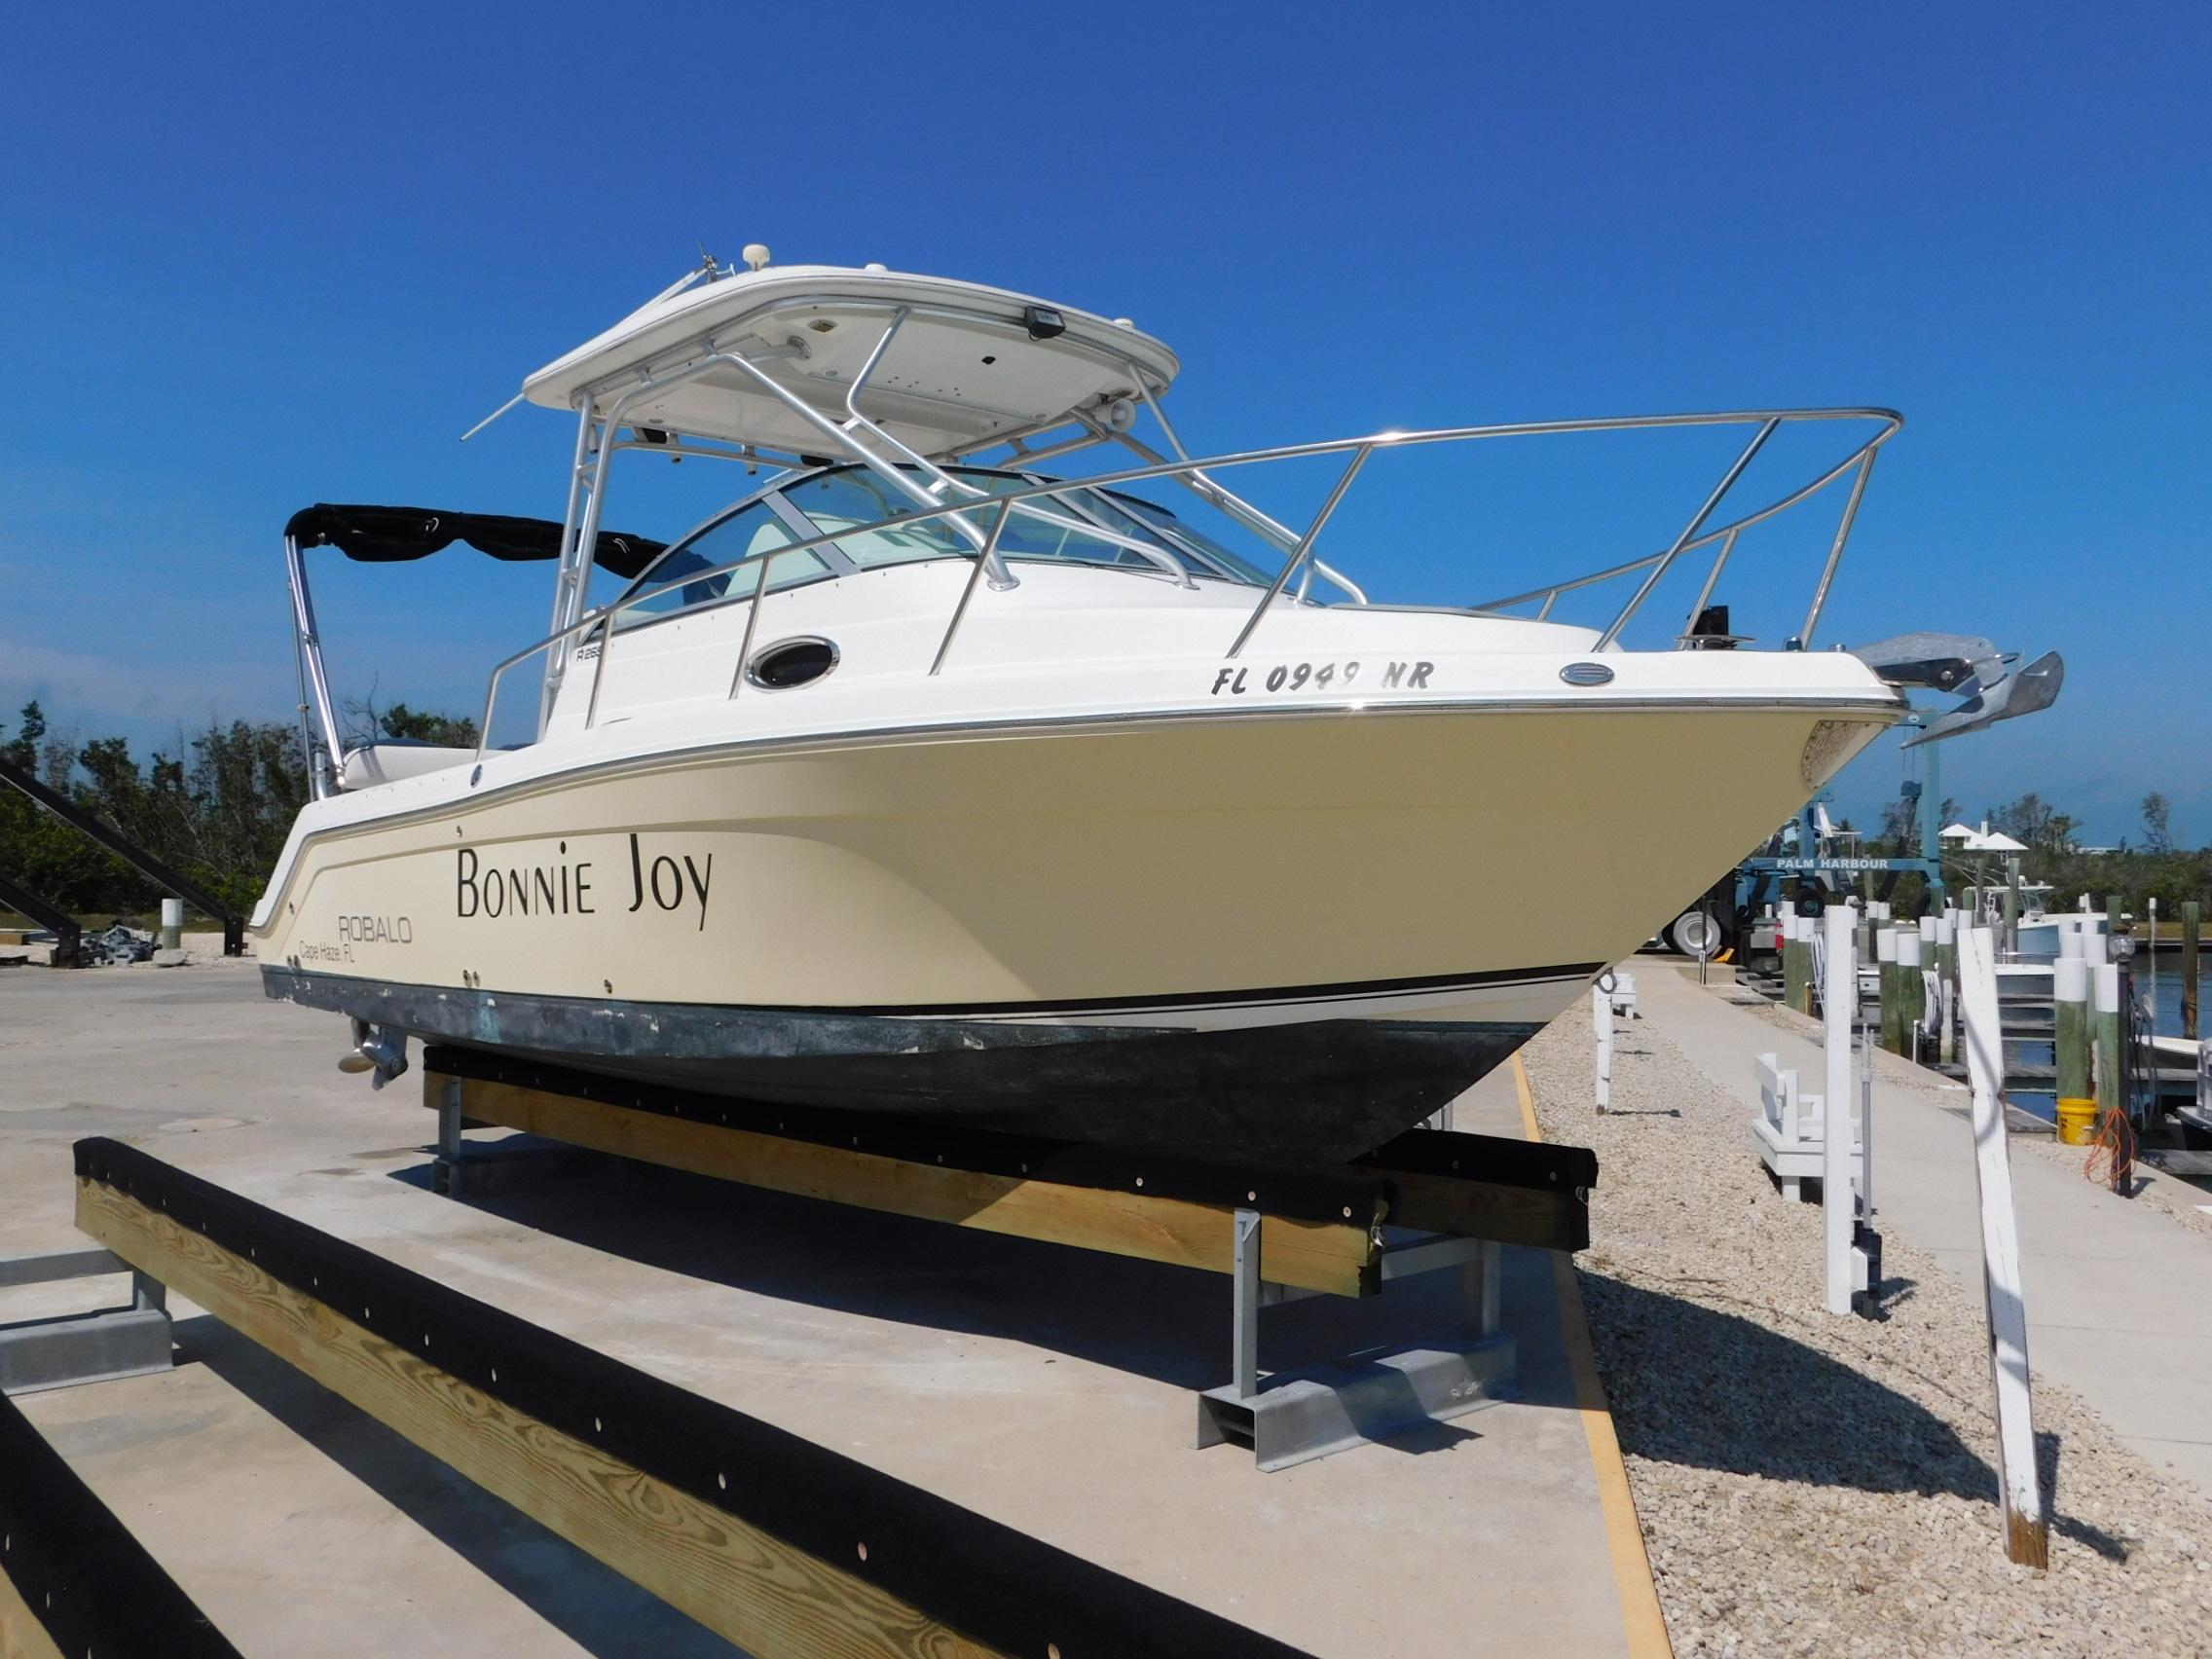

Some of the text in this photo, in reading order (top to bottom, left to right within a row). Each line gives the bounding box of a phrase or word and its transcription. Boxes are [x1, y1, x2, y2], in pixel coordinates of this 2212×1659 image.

[1211, 661, 1434, 695] FL 0949 NR
[1777, 859, 1889, 869] PALM HARBOUR
[339, 915, 412, 943] ROBALO
[299, 940, 318, 963] Cape
[344, 942, 355, 963] FL
